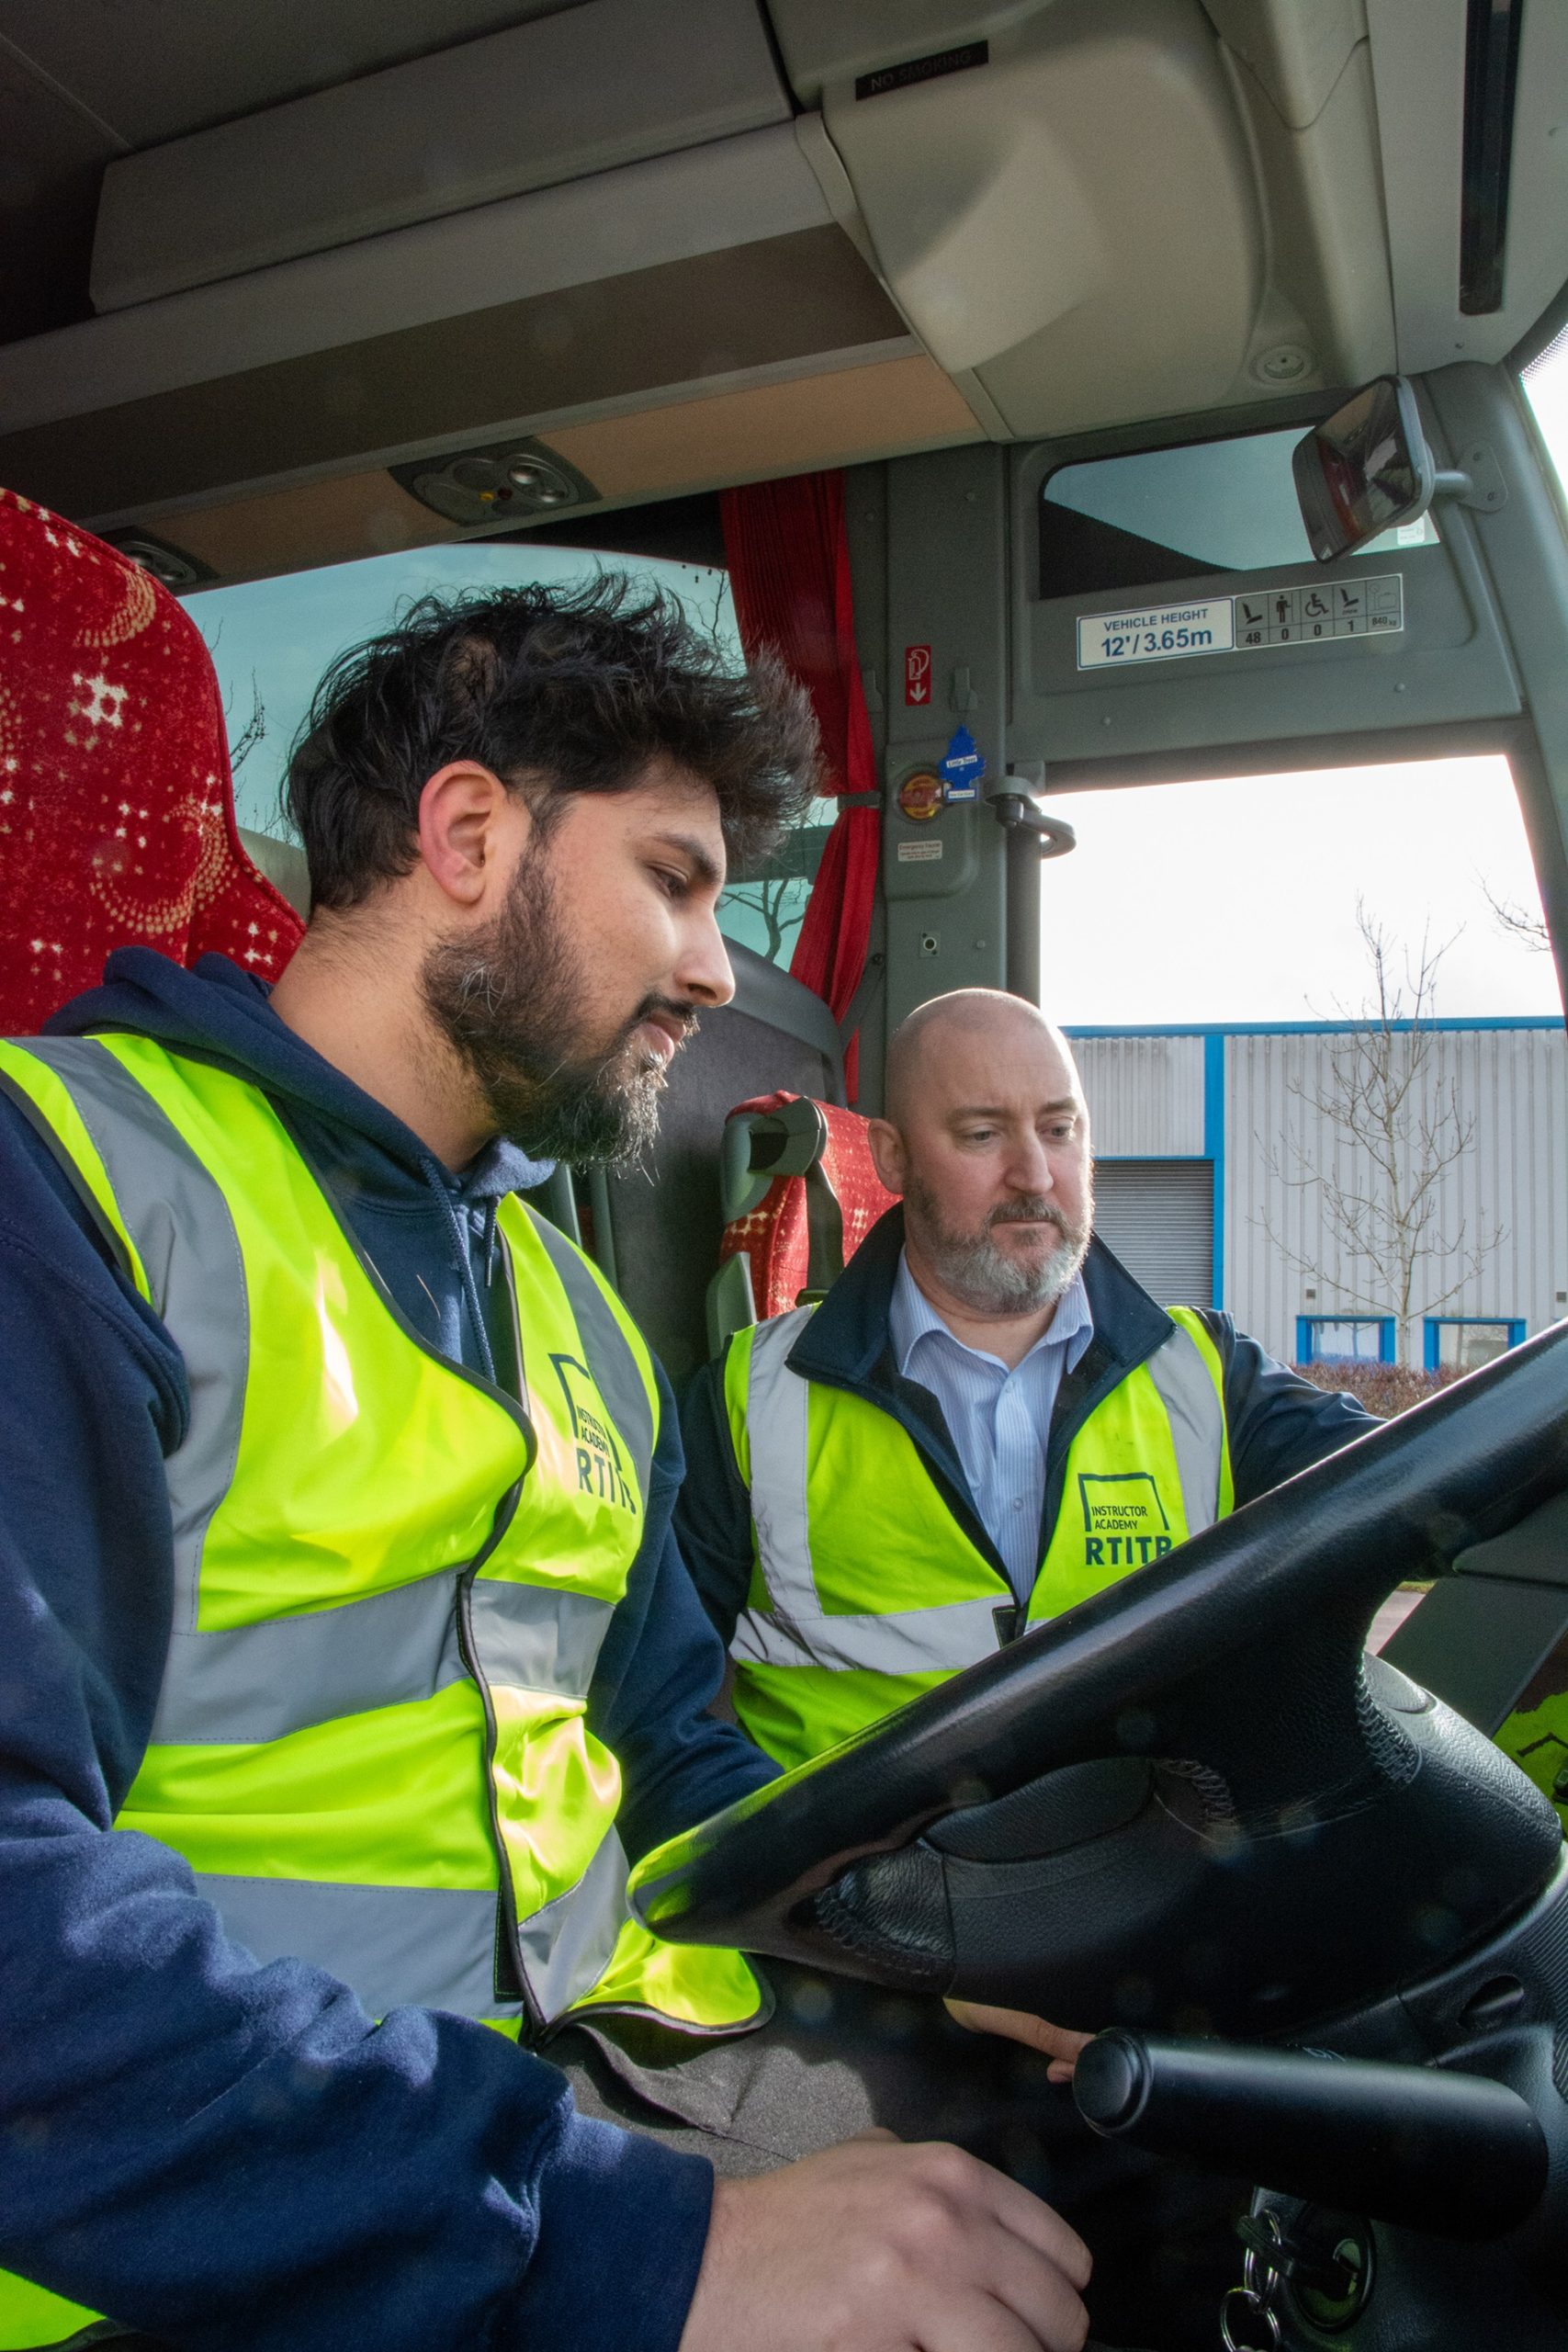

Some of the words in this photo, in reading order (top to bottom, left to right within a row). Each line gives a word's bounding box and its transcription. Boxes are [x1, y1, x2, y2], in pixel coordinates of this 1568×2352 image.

[871, 74, 895, 91] NO
[899, 51, 971, 83] SMOKING
[1104, 616, 1157, 632] VEHICLE
[1161, 608, 1209, 625] HEIGHT
[1246, 631, 1261, 644] 48
[1281, 628, 1290, 640] 0
[1314, 624, 1322, 637] 0
[1348, 619, 1354, 632] 1
[1371, 616, 1388, 626] 840
[1091, 1506, 1147, 1517] INSTRUCTOR
[1094, 1519, 1138, 1530] ACADEMY
